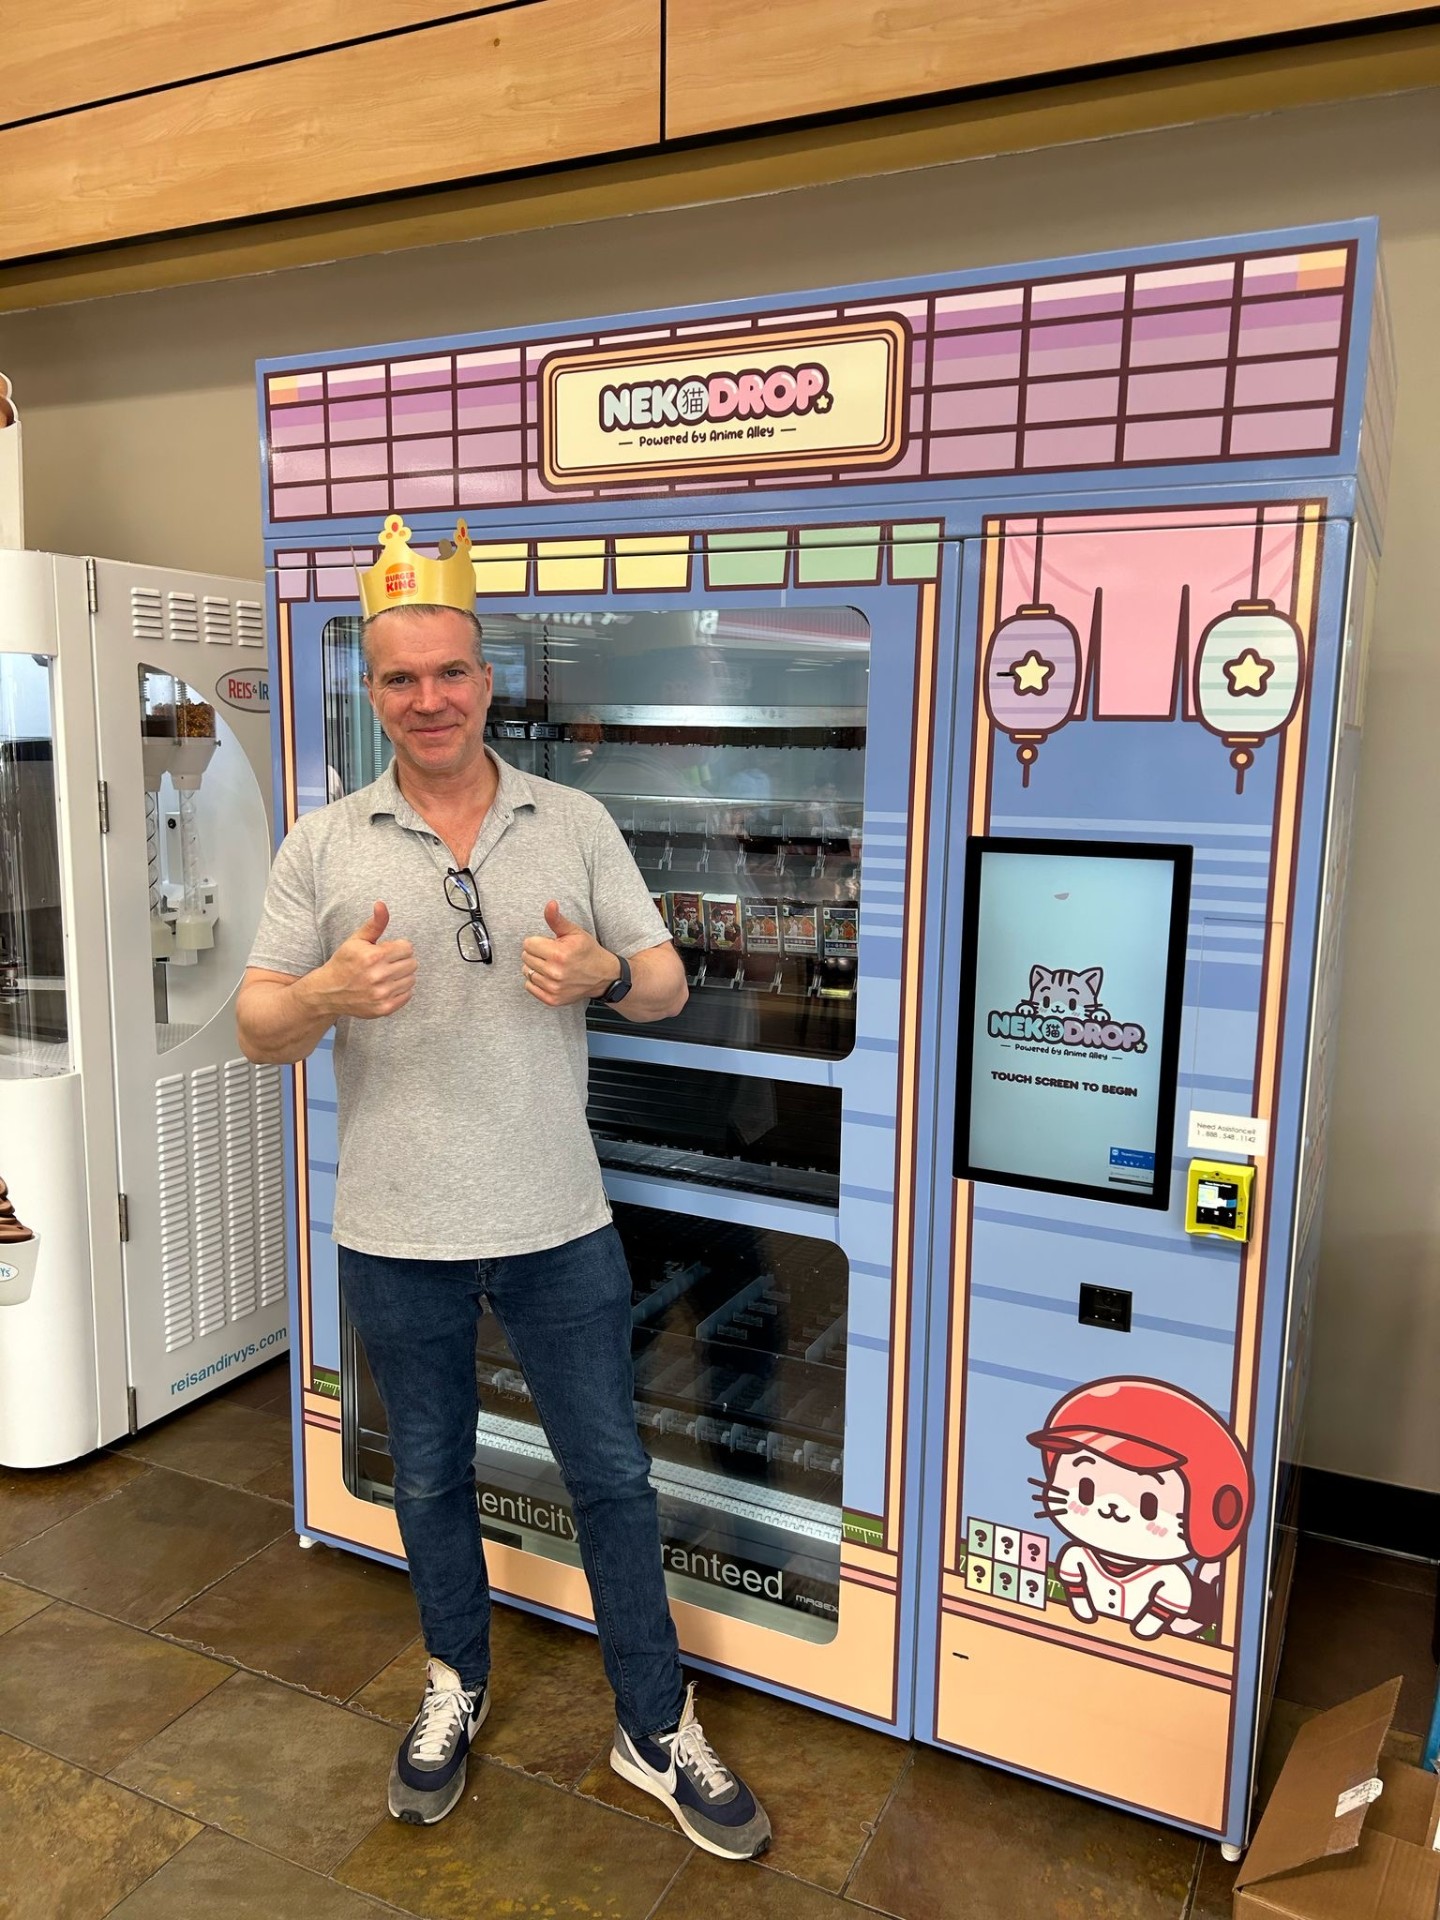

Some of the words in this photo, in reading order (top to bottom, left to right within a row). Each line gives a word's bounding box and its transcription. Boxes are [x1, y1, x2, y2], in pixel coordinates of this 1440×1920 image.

[639, 433, 688, 447] Powered
[691, 430, 707, 444] by
[710, 429, 744, 442] Anime
[747, 426, 775, 441] Alley
[385, 571, 416, 583] BURGER
[386, 579, 416, 593] KING
[228, 678, 253, 699] REIS
[1015, 1043, 1049, 1054] Powered
[1051, 1047, 1062, 1056] by
[1063, 1049, 1087, 1058] Anime
[1089, 1051, 1108, 1060] Alley
[991, 1071, 1032, 1084] TOUCH
[1035, 1076, 1079, 1090] SCREEN
[1082, 1082, 1099, 1092] TO
[1102, 1085, 1137, 1097] BEGIN
[1197, 1122, 1216, 1130] Need
[171, 1327, 287, 1395] reisandirvys.com
[476, 1490, 579, 1542] enticity
[661, 1543, 783, 1600] ranteed
